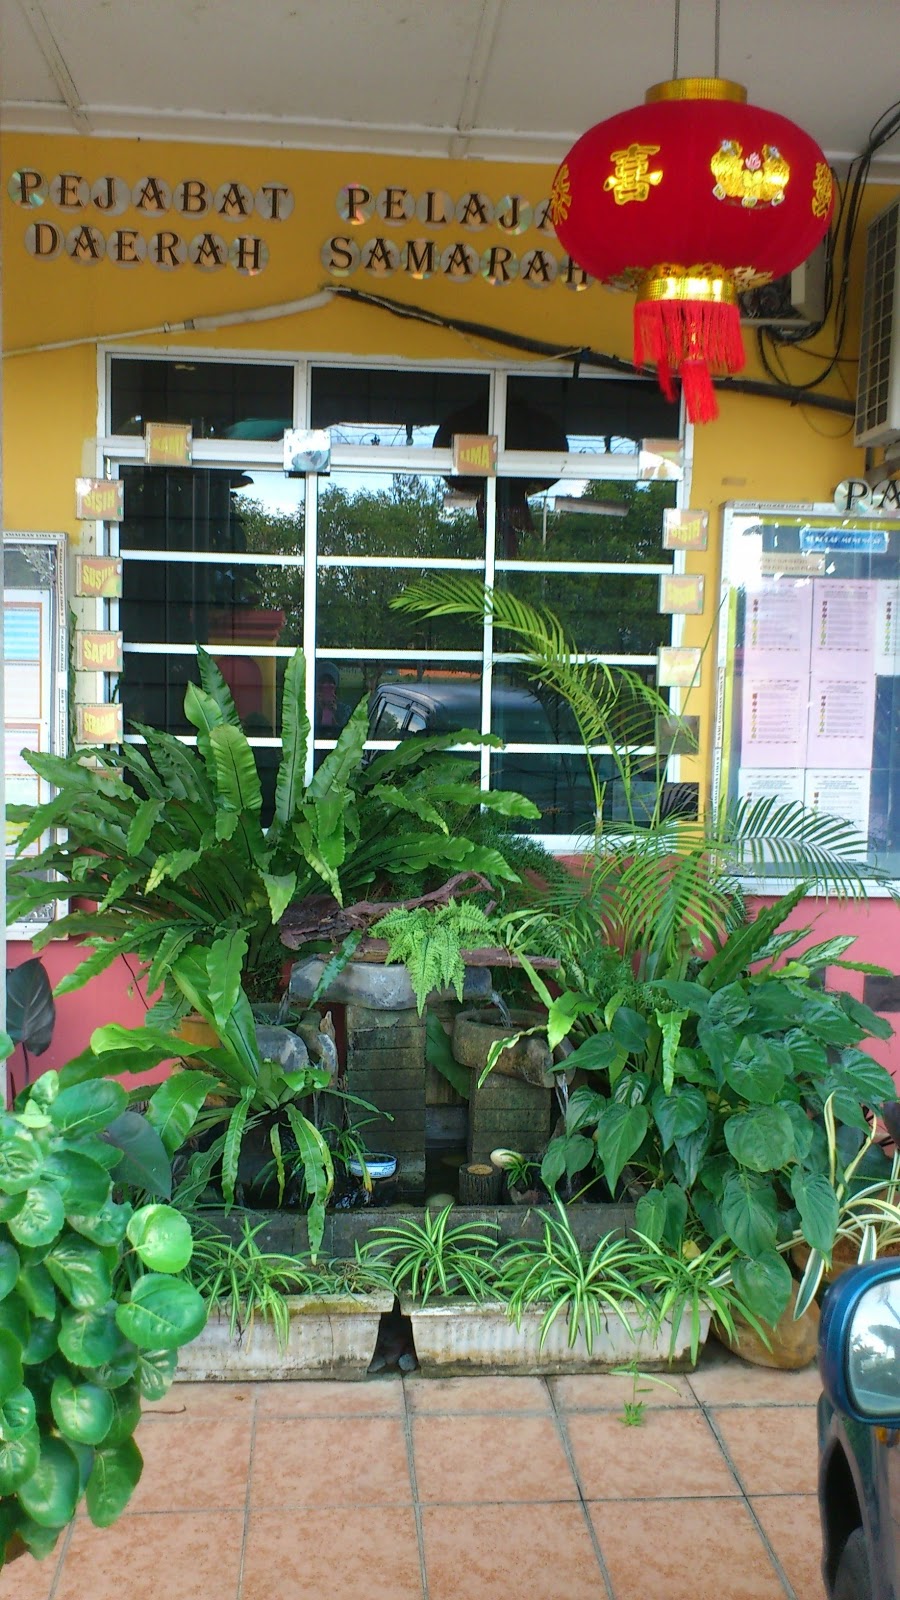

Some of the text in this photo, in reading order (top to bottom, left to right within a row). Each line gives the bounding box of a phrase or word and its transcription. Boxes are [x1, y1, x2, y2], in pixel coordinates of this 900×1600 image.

[17, 170, 289, 220] PEJABAT
[33, 222, 262, 271] DAERAH
[459, 444, 490, 469] LIMA
[83, 638, 115, 665] SAPU
